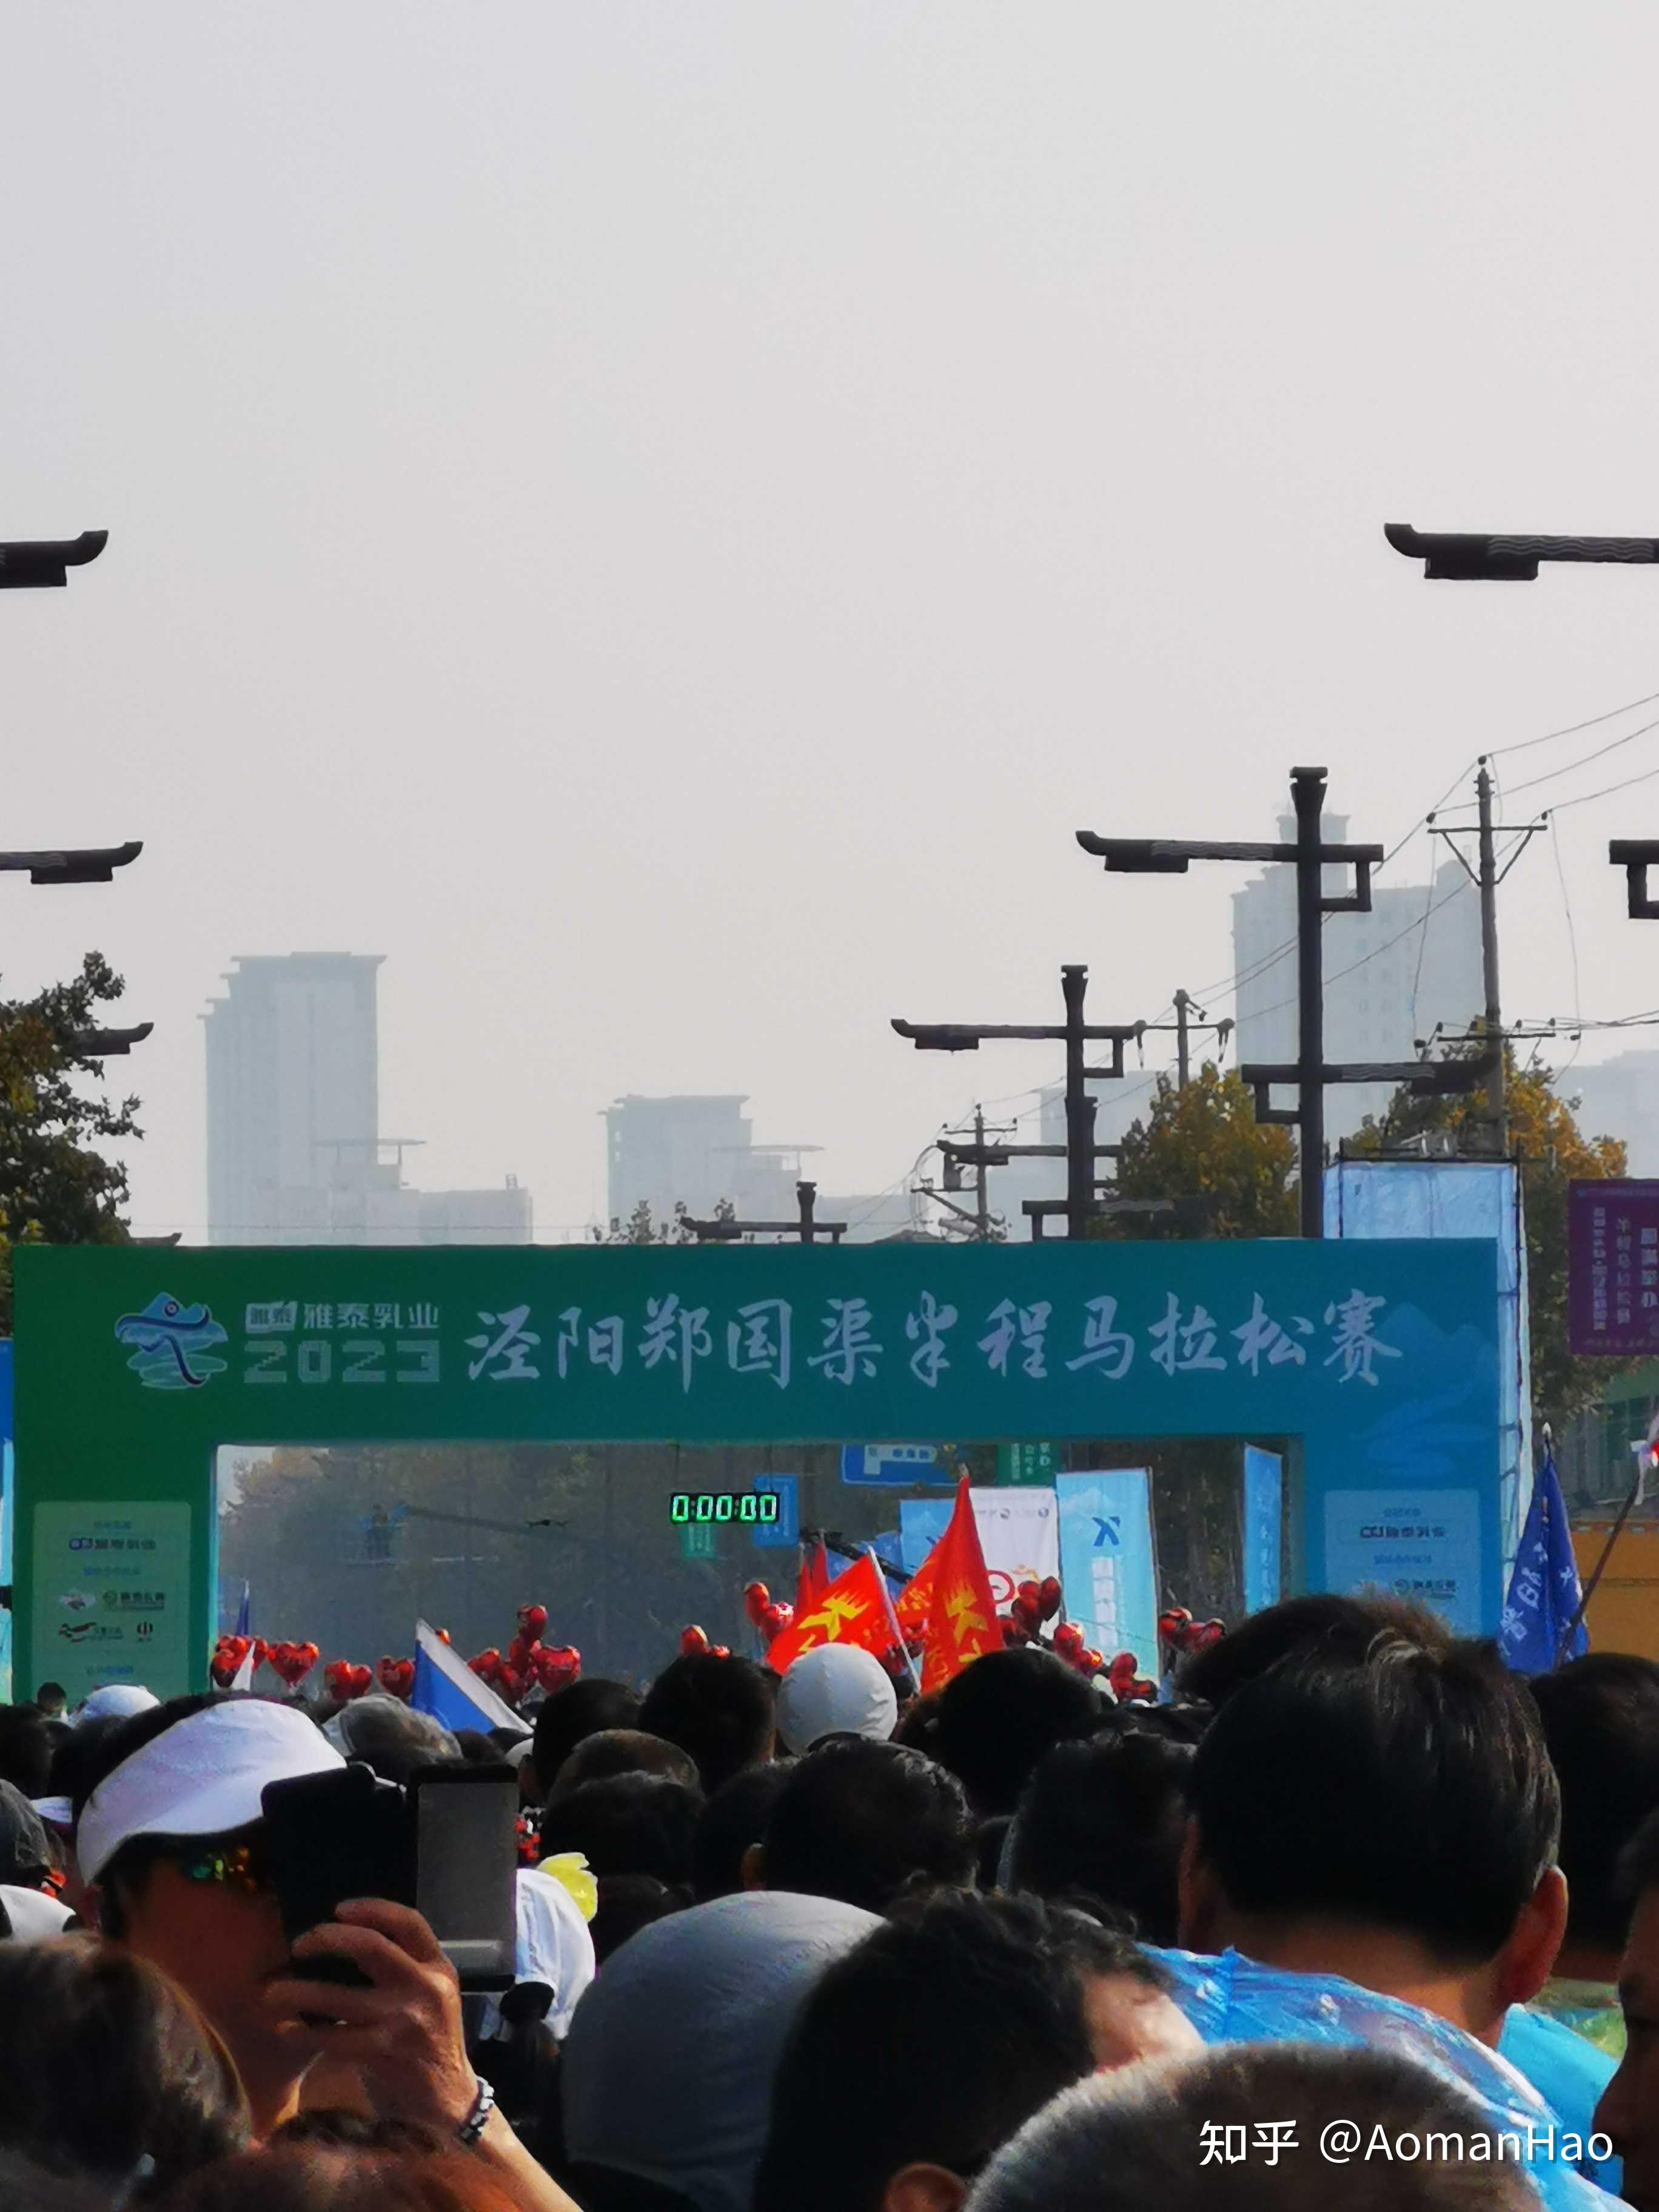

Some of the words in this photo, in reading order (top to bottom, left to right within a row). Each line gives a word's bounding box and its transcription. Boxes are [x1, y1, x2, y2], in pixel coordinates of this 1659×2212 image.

[303, 1301, 440, 1329] 雅泰乳业
[464, 1287, 1403, 1393] 泾阳郑国渠半程马拉松赛
[243, 1339, 440, 1383] 2023
[672, 1495, 777, 1521] 0:00:00
